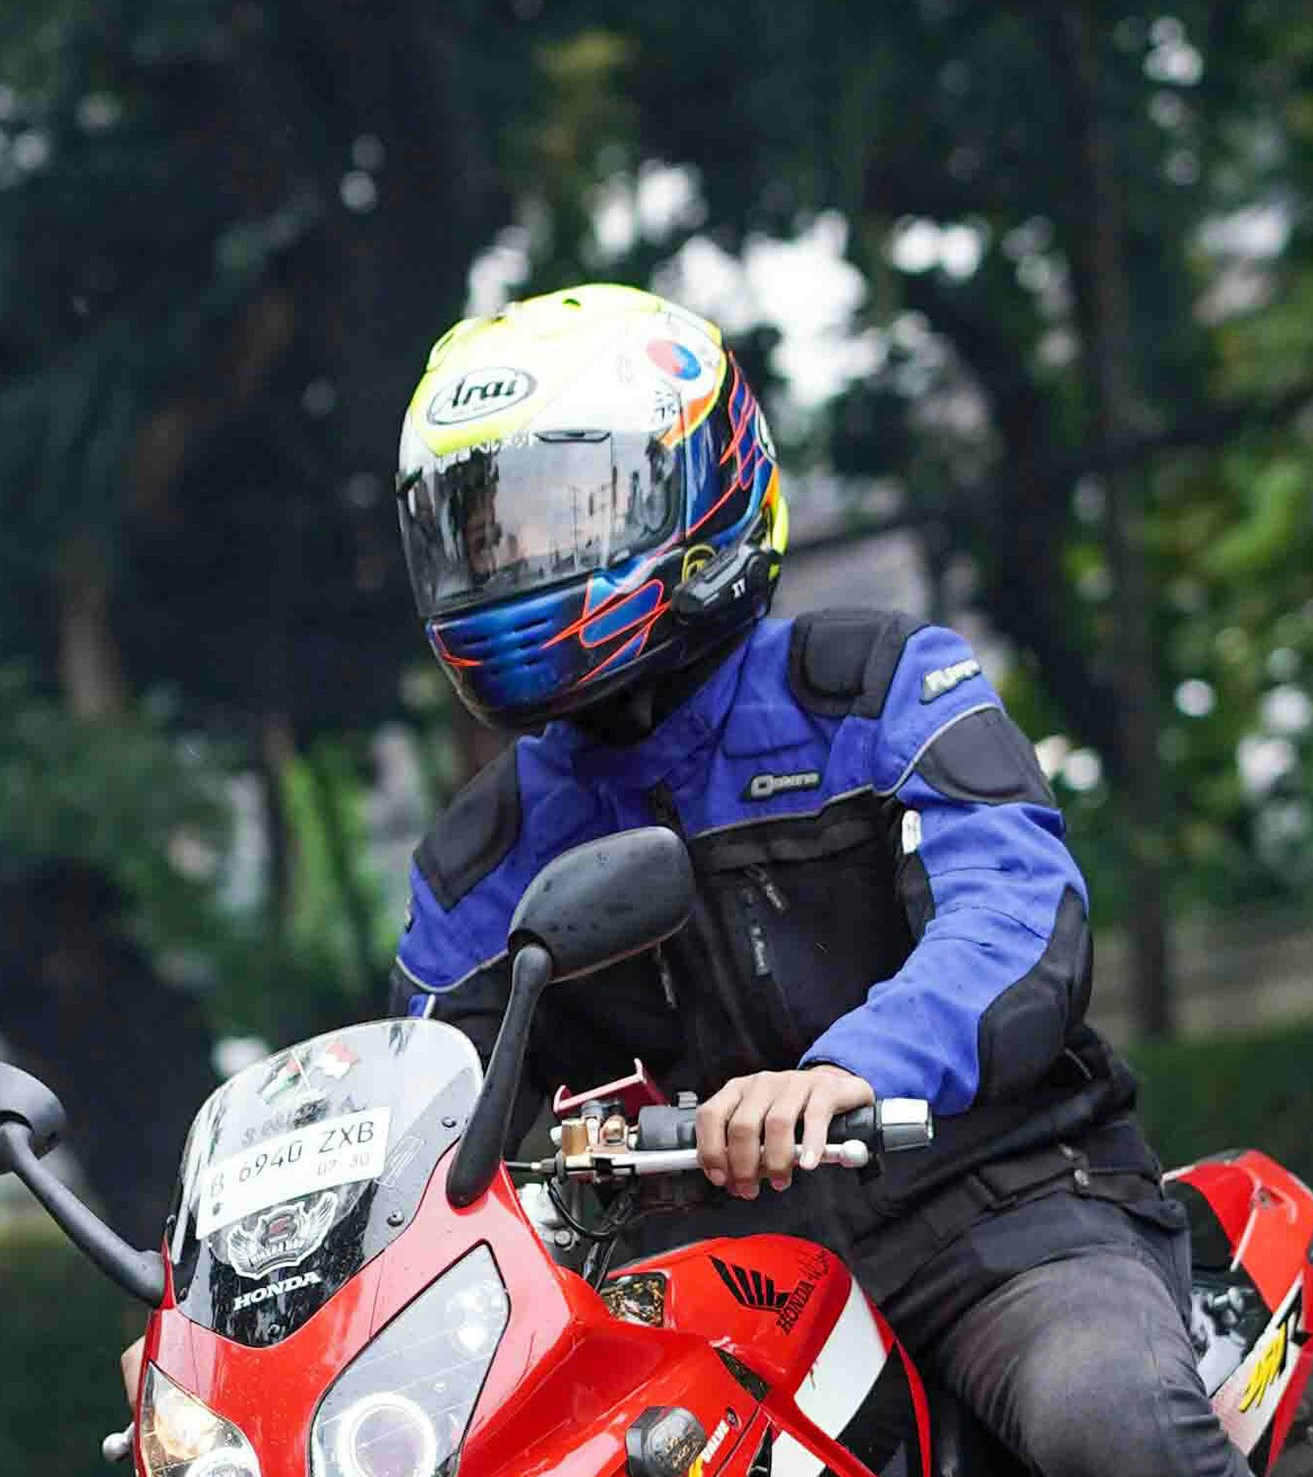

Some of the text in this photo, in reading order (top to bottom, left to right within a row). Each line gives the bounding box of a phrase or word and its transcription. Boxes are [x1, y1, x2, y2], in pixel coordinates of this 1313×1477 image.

[442, 377, 517, 409] Arai
[239, 1140, 303, 1183] 6940
[318, 1121, 374, 1154] ZXB
[233, 1271, 322, 1311] HONDA
[776, 1280, 815, 1335] HONDA
[700, 1419, 729, 1464] VALVE
